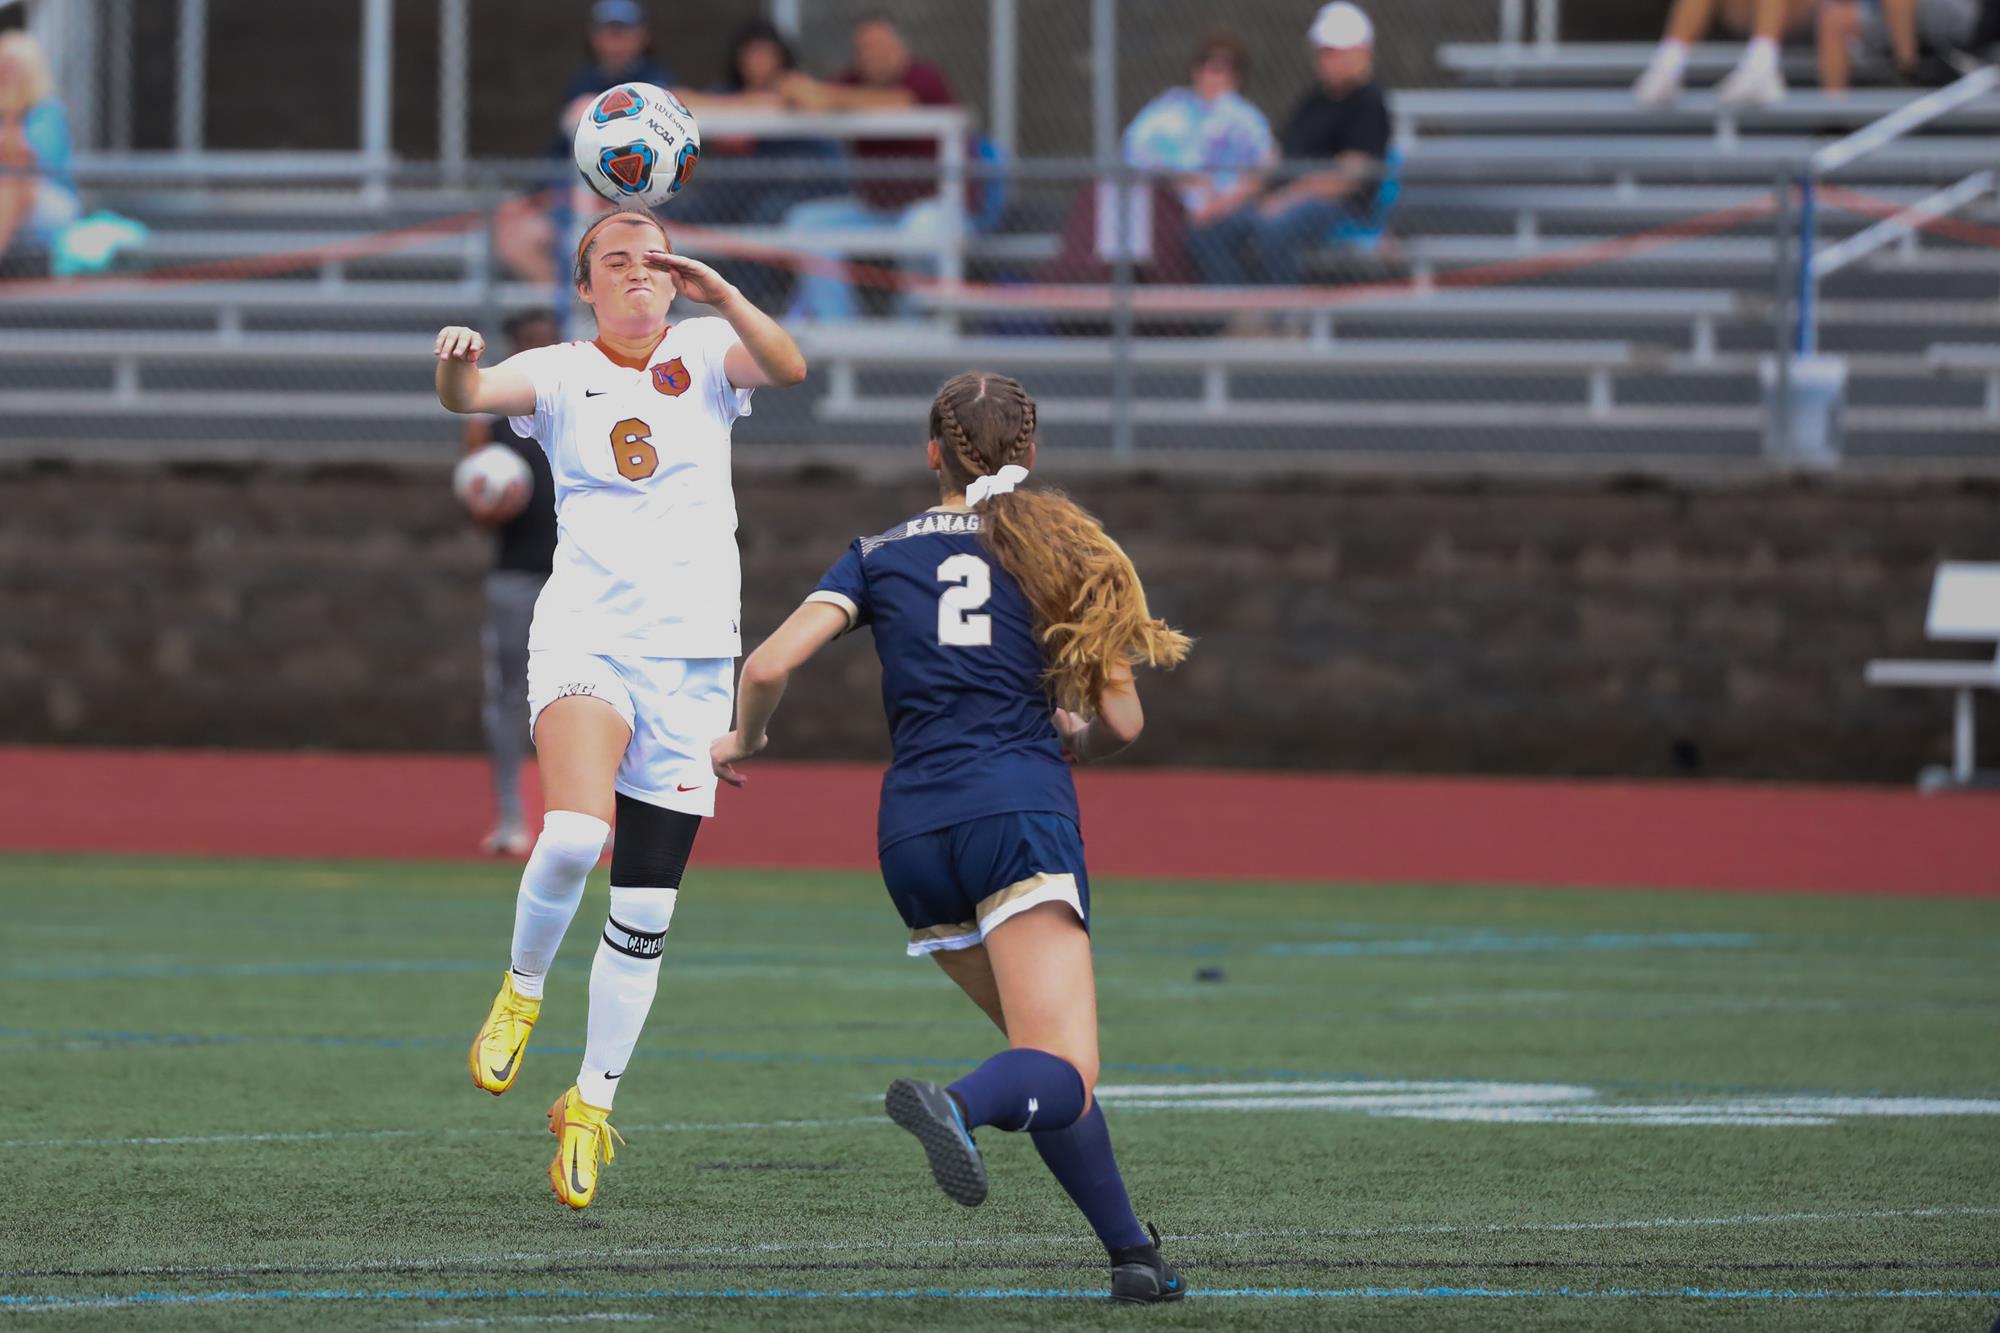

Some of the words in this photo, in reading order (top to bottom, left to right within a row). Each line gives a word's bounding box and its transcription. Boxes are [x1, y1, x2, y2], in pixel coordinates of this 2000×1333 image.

[646, 118, 675, 147] NCAA
[609, 417, 660, 482] 6
[937, 553, 992, 646] 2
